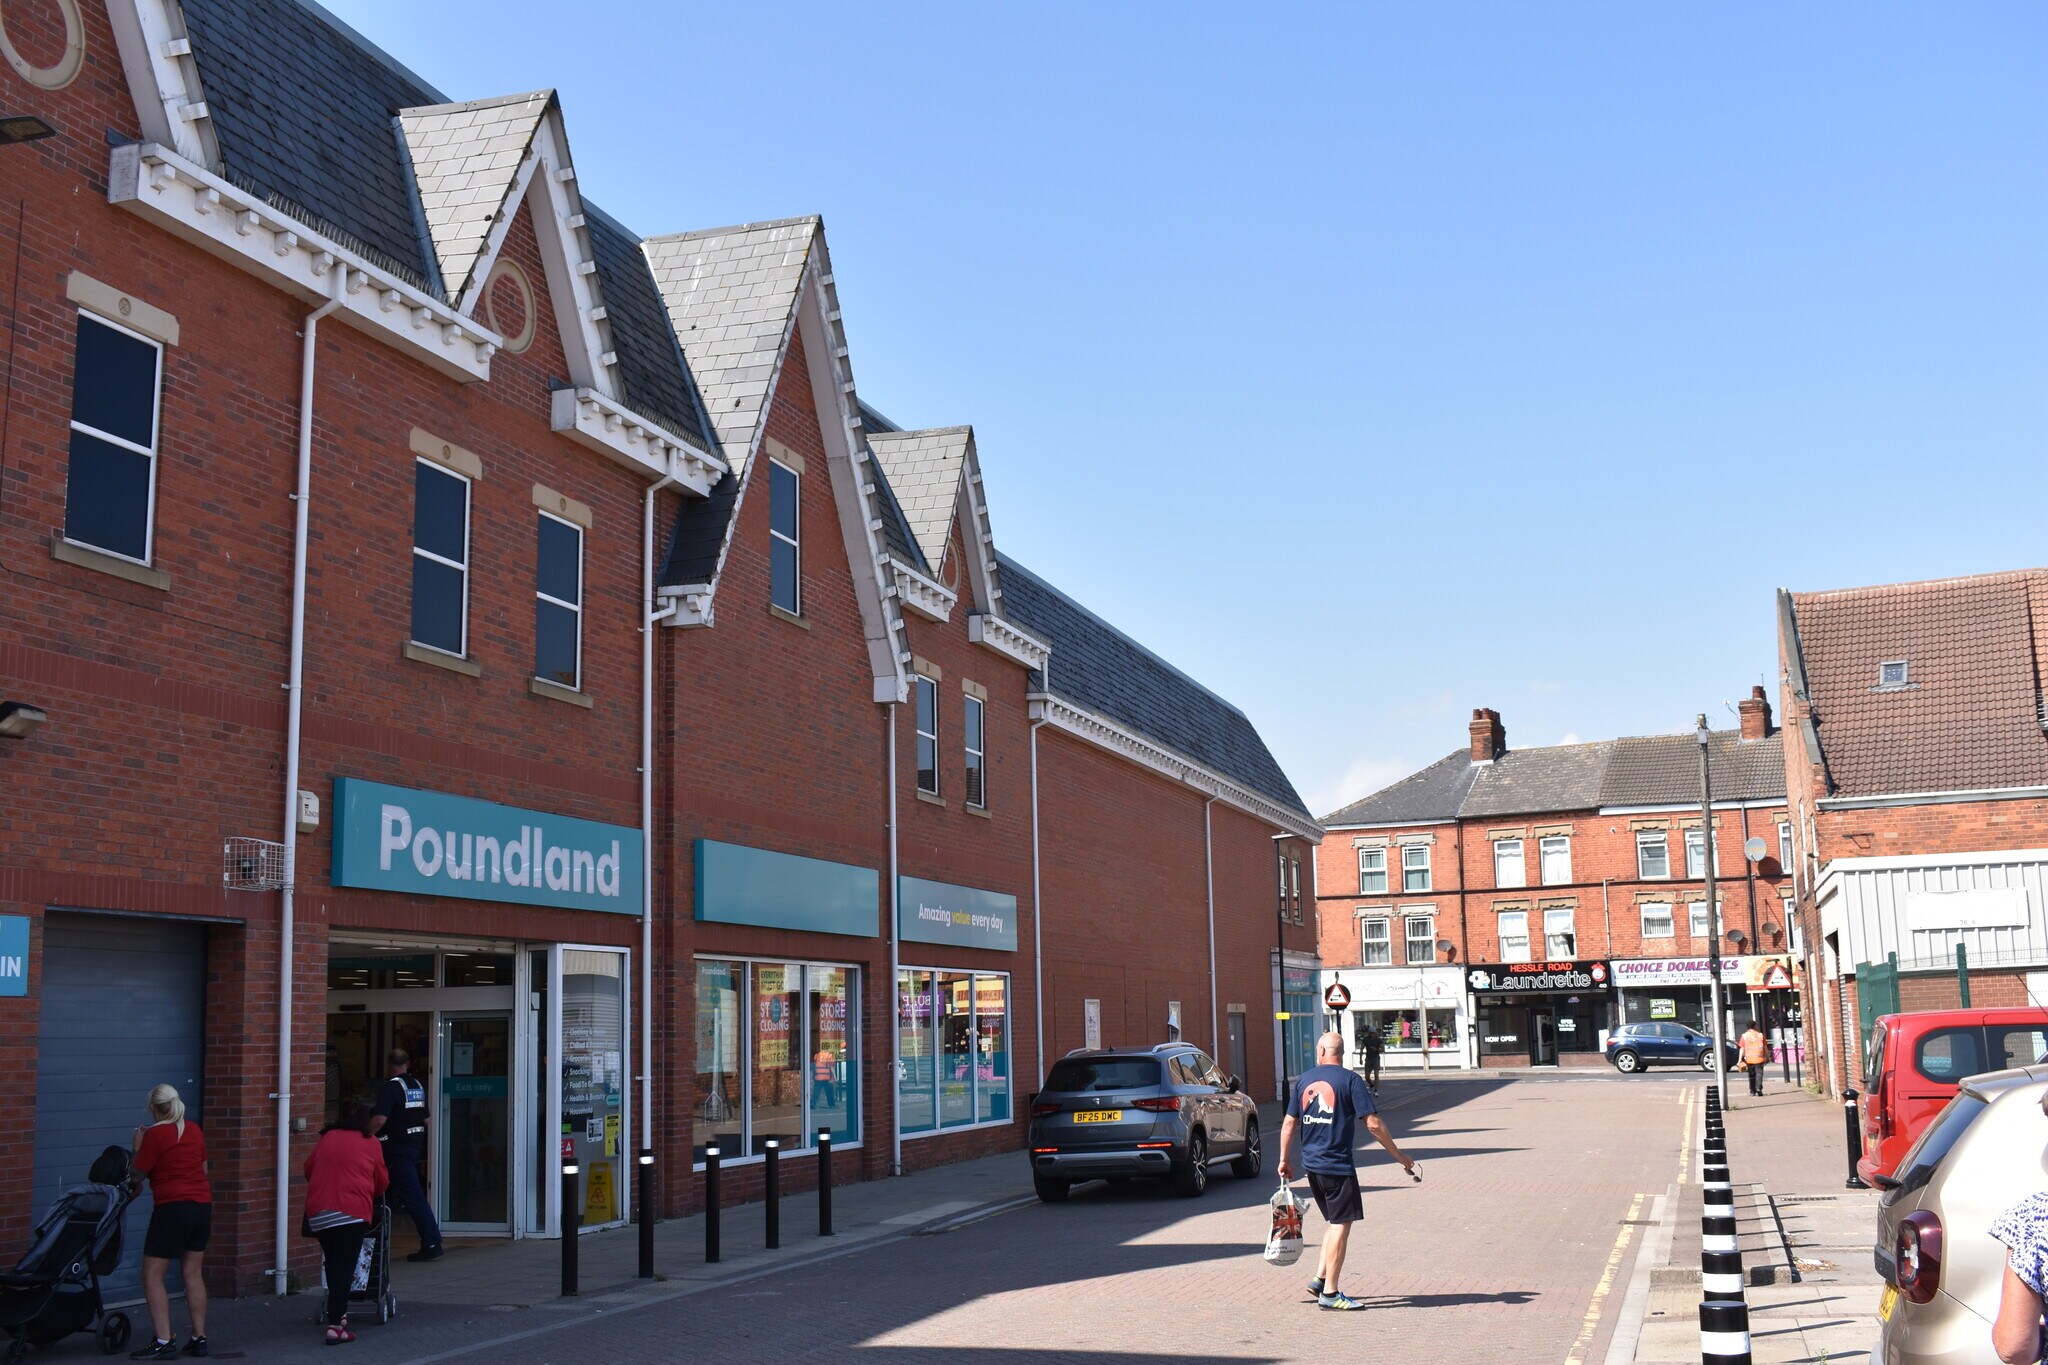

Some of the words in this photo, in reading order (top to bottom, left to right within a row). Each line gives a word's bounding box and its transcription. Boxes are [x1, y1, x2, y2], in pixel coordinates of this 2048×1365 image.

[380, 803, 620, 897] Poundland
[918, 903, 950, 927] Amazing
[951, 908, 971, 925] value
[971, 914, 990, 932] every
[990, 913, 1004, 934] day
[0, 956, 21, 978] IN
[701, 967, 726, 976] Poundland
[1510, 964, 1544, 973] HESSLE
[1547, 963, 1573, 971] ROAD
[1618, 962, 1663, 973] CHOICE
[1667, 960, 1739, 972] DOMESICS
[761, 971, 785, 980] EVERYTHIN
[1491, 970, 1592, 990] Laundrette
[760, 1002, 789, 1018] STE
[820, 1003, 846, 1019] STORE
[760, 1019, 789, 1032] CLOSING
[820, 1020, 846, 1032] CLOSING
[1500, 1035, 1517, 1043] OPEN
[569, 1068, 591, 1078] Snacking
[456, 1083, 472, 1092] Exit
[474, 1082, 492, 1094] only
[569, 1081, 581, 1089] Food
[569, 1094, 584, 1102] Health
[590, 1094, 606, 1102] Beauty
[569, 1107, 593, 1116] Household
[1077, 1113, 1099, 1122] BF25
[1101, 1111, 1118, 1121] DWC
